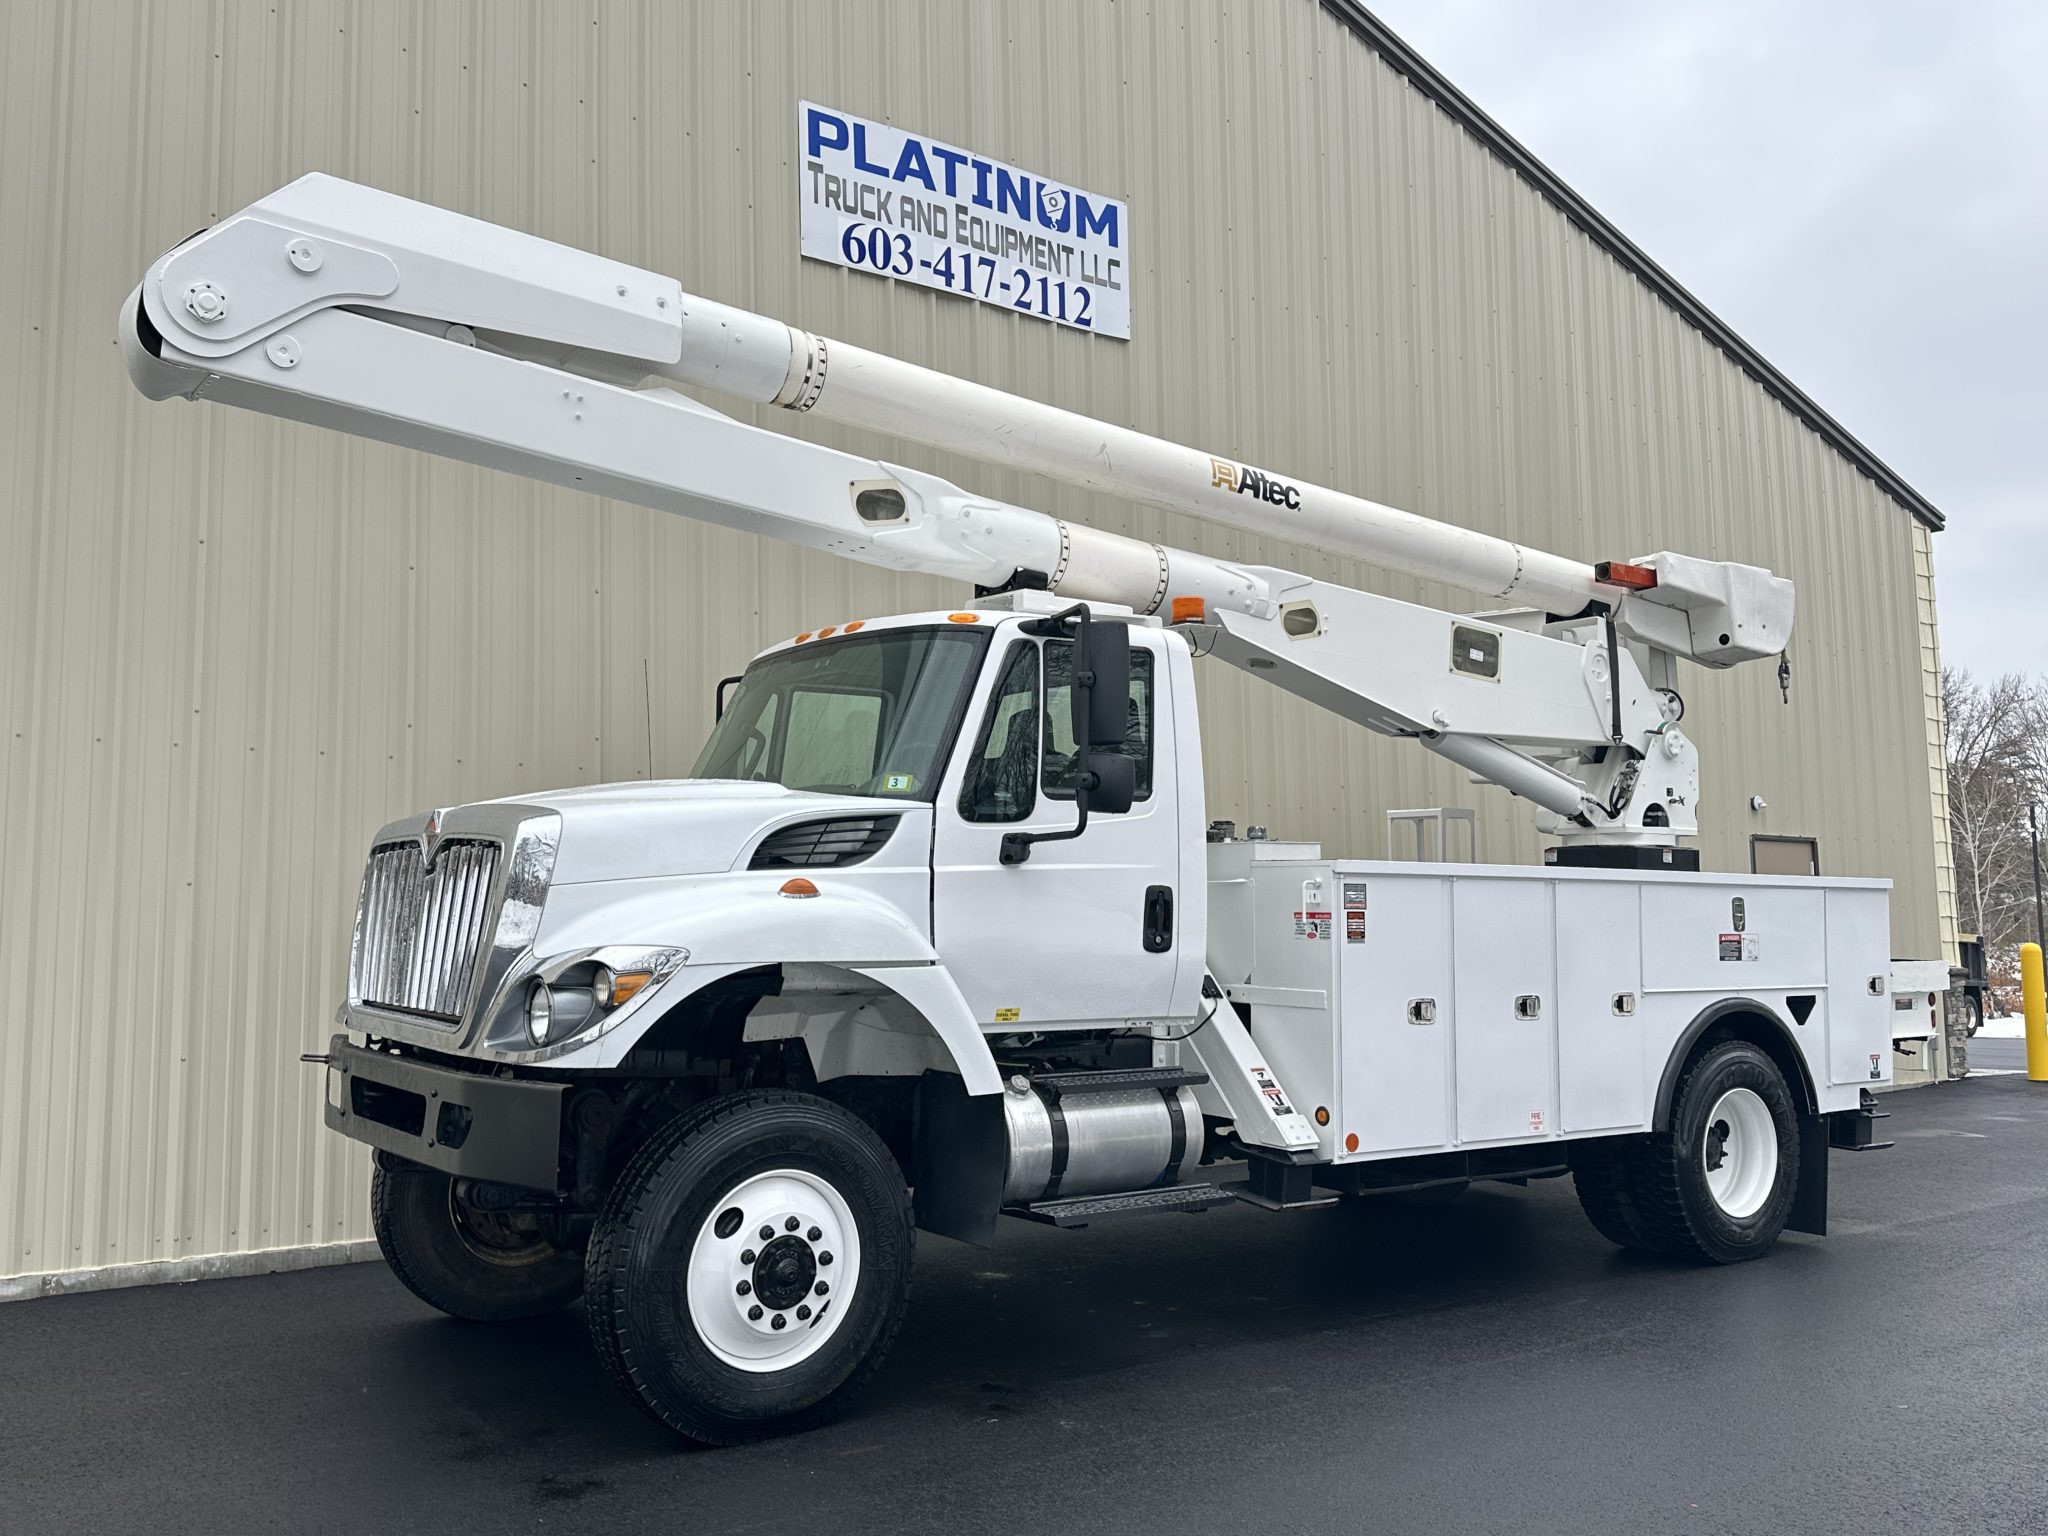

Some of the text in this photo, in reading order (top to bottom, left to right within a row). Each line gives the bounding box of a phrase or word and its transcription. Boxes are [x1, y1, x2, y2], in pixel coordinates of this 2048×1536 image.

[807, 108, 1118, 248] PLATINUM
[841, 222, 1093, 327] 603-417-2112
[900, 195, 948, 240] AND
[1081, 250, 1121, 291] LLC
[1237, 467, 1301, 511] Altec
[891, 777, 899, 788] 3
